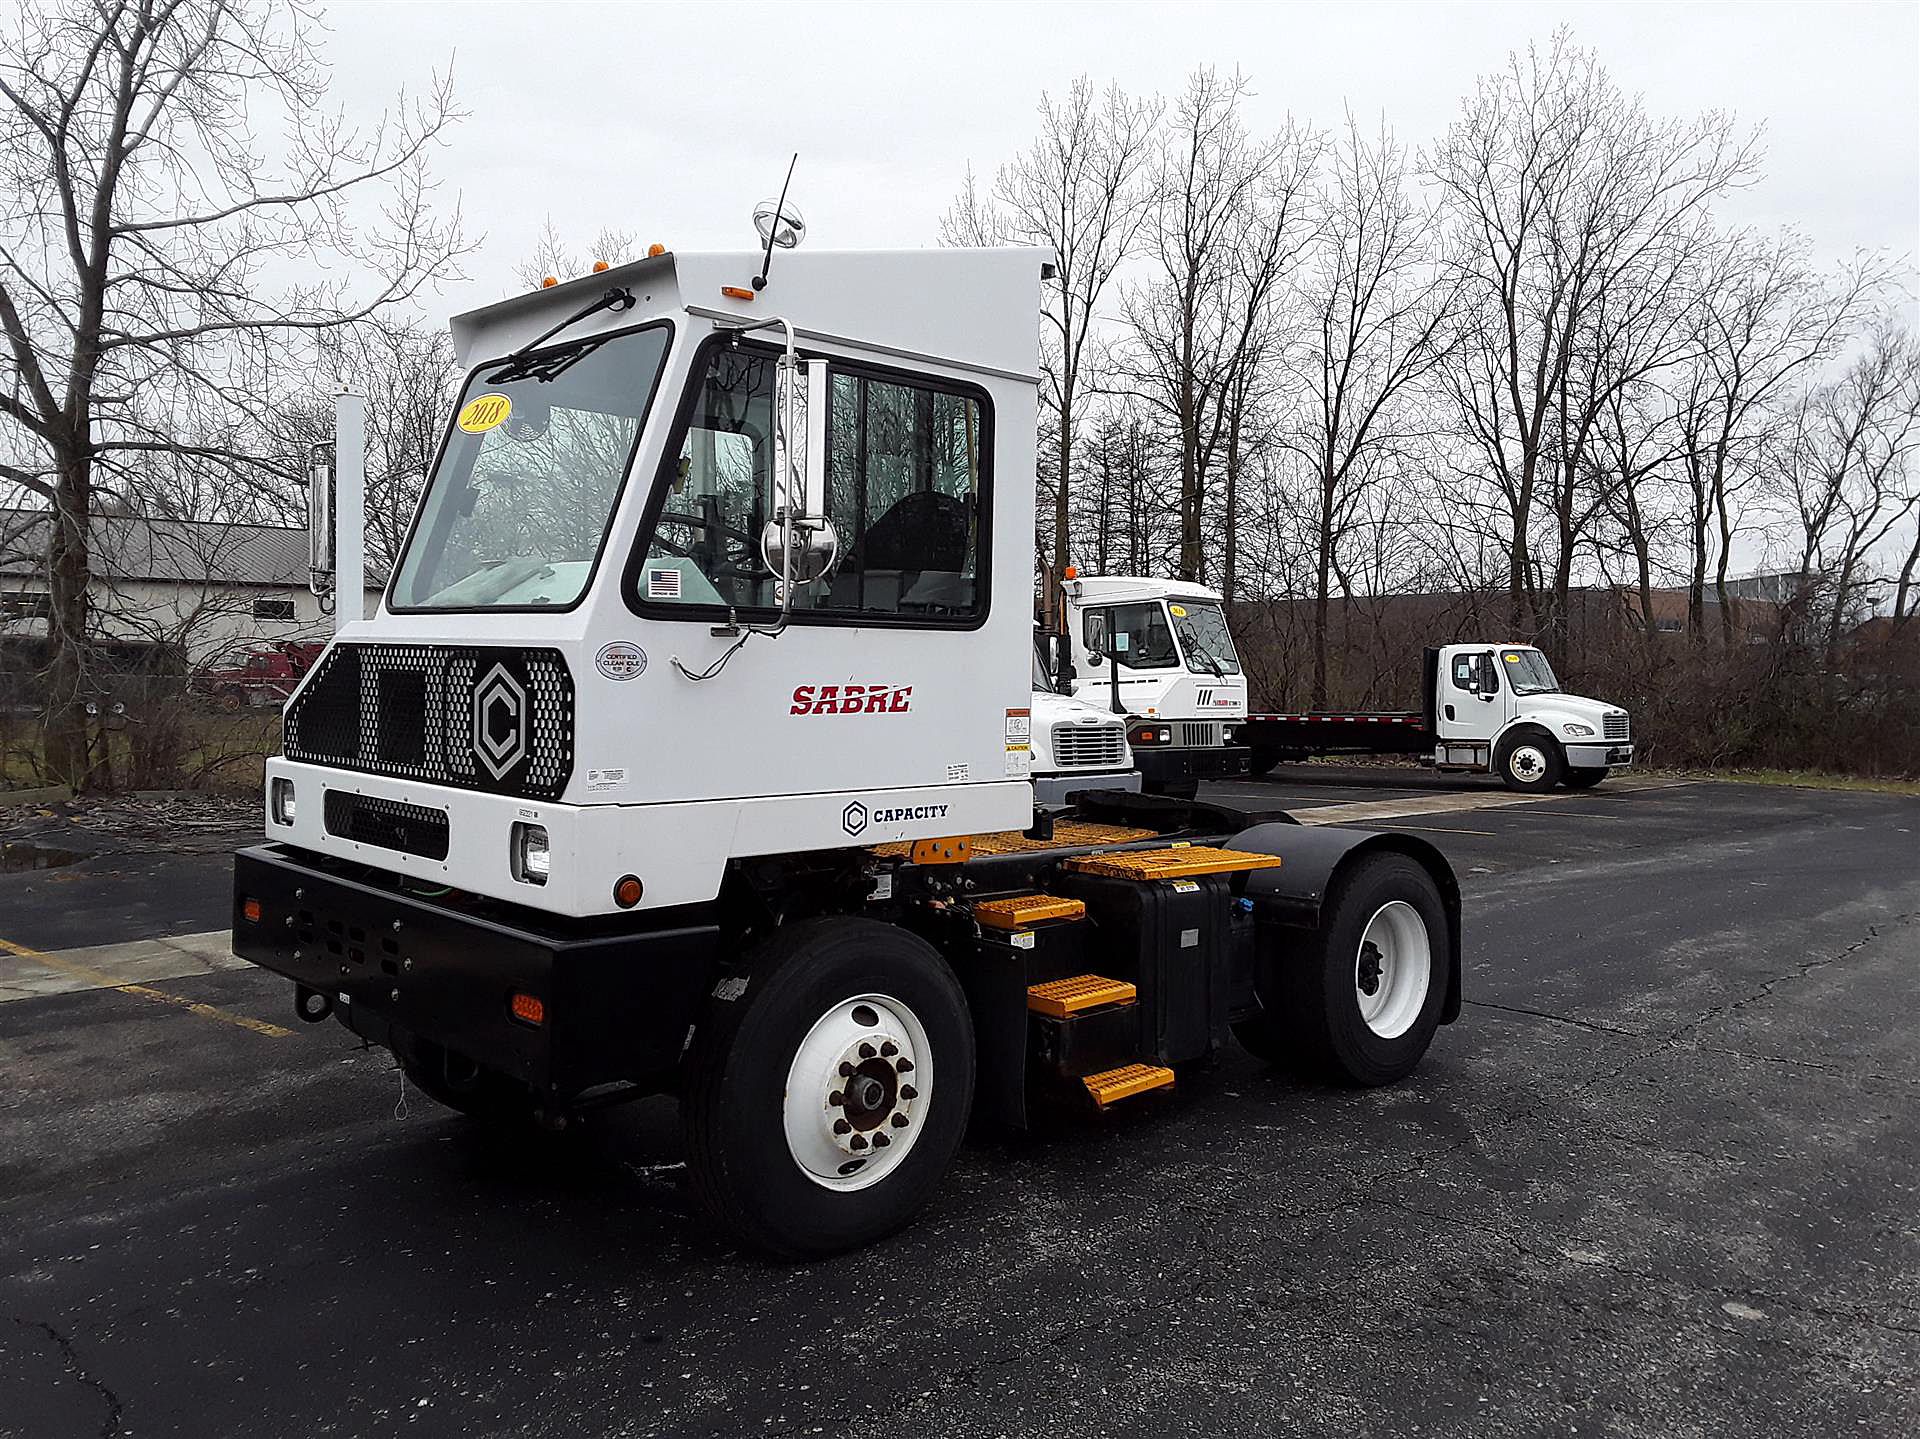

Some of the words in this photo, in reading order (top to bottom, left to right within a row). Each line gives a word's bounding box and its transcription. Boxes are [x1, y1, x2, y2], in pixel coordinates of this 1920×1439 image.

[463, 400, 505, 426] 2018
[790, 686, 912, 715] SABRE
[874, 805, 948, 823] CAPACITY
